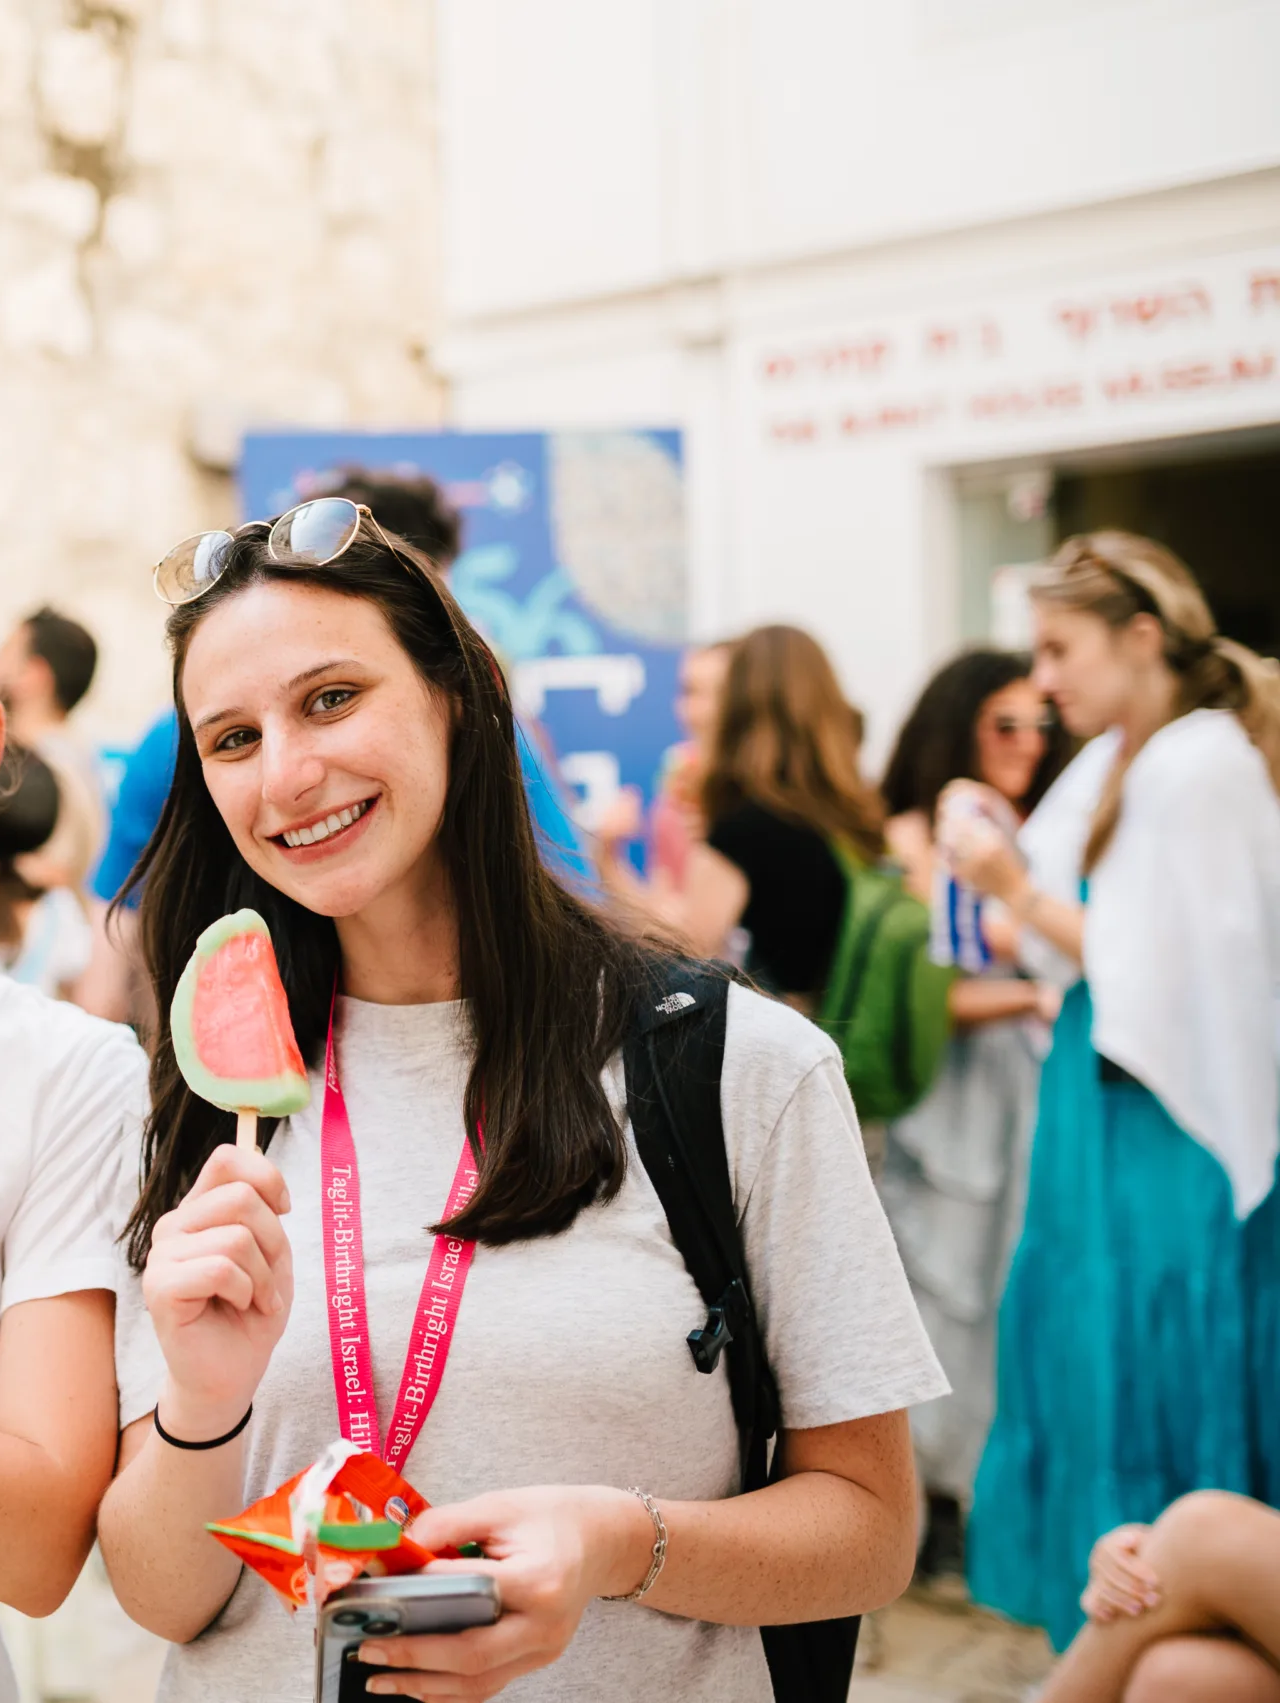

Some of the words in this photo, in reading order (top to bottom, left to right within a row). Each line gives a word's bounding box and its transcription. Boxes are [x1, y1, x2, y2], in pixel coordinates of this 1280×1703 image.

[655, 998, 682, 1012] NORTH
[327, 1164, 359, 1330] Taglit-Birthright
[431, 1233, 465, 1292] Israel
[340, 1335, 367, 1404] Israel:
[348, 1410, 373, 1453] Hill
